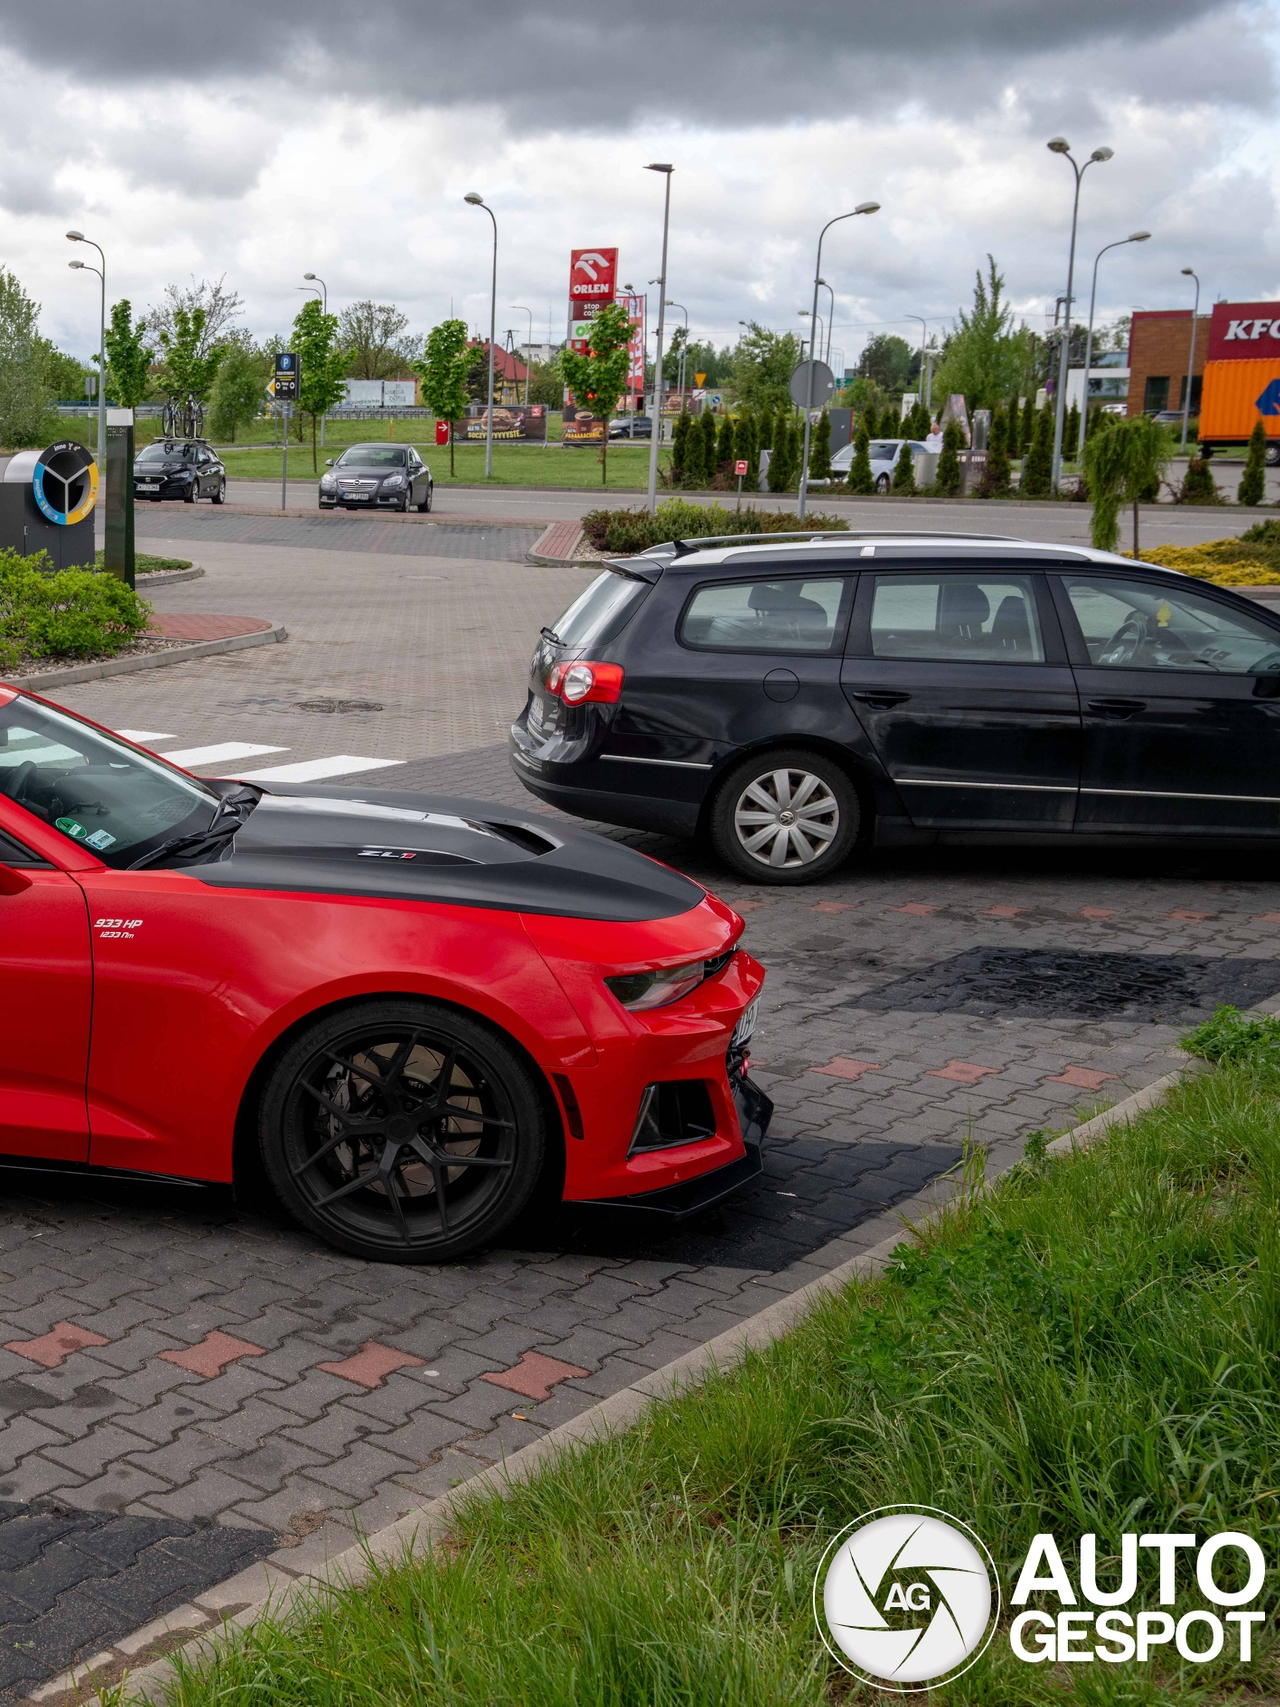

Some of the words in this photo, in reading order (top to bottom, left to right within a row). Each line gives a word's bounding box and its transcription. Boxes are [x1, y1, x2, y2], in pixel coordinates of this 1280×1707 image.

[573, 284, 609, 294] ORLEN
[583, 303, 600, 311] stop
[94, 918, 123, 929] 933
[122, 919, 144, 929] HP
